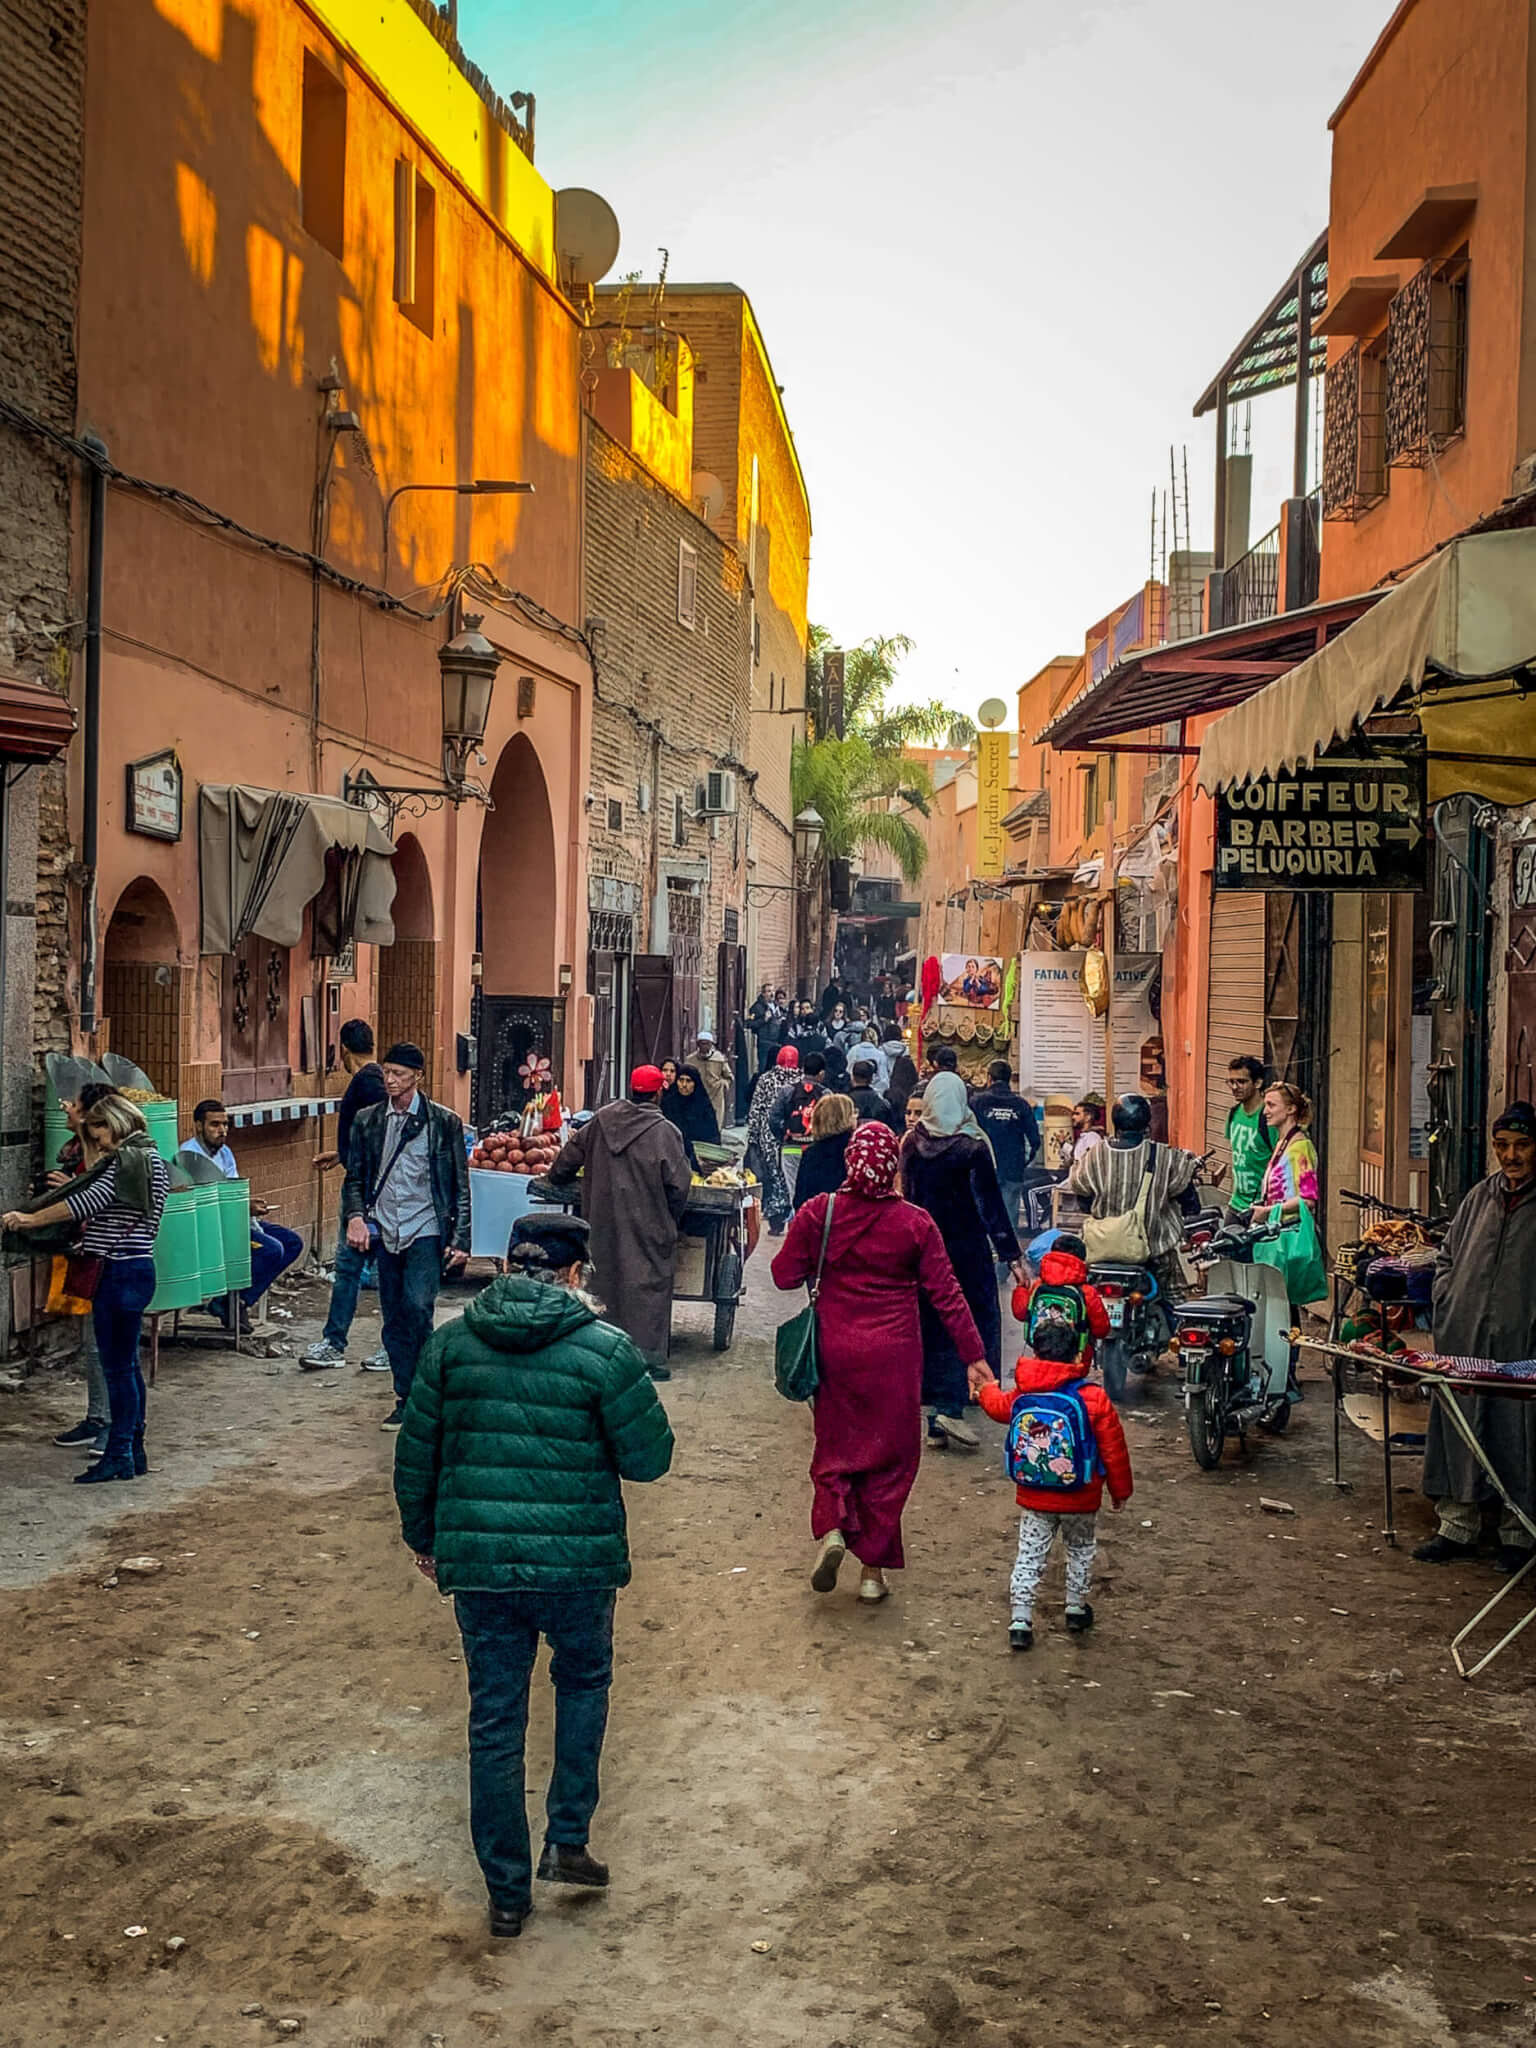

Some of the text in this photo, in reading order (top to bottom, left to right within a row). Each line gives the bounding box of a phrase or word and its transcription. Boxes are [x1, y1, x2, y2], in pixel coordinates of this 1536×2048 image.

[983, 740, 1001, 866] Le Jardin Secret
[1226, 782, 1409, 812] COIFFEUR
[1231, 819, 1380, 847] BARBER
[1221, 848, 1377, 876] PELUQURIA
[1034, 969, 1068, 980] FATNA
